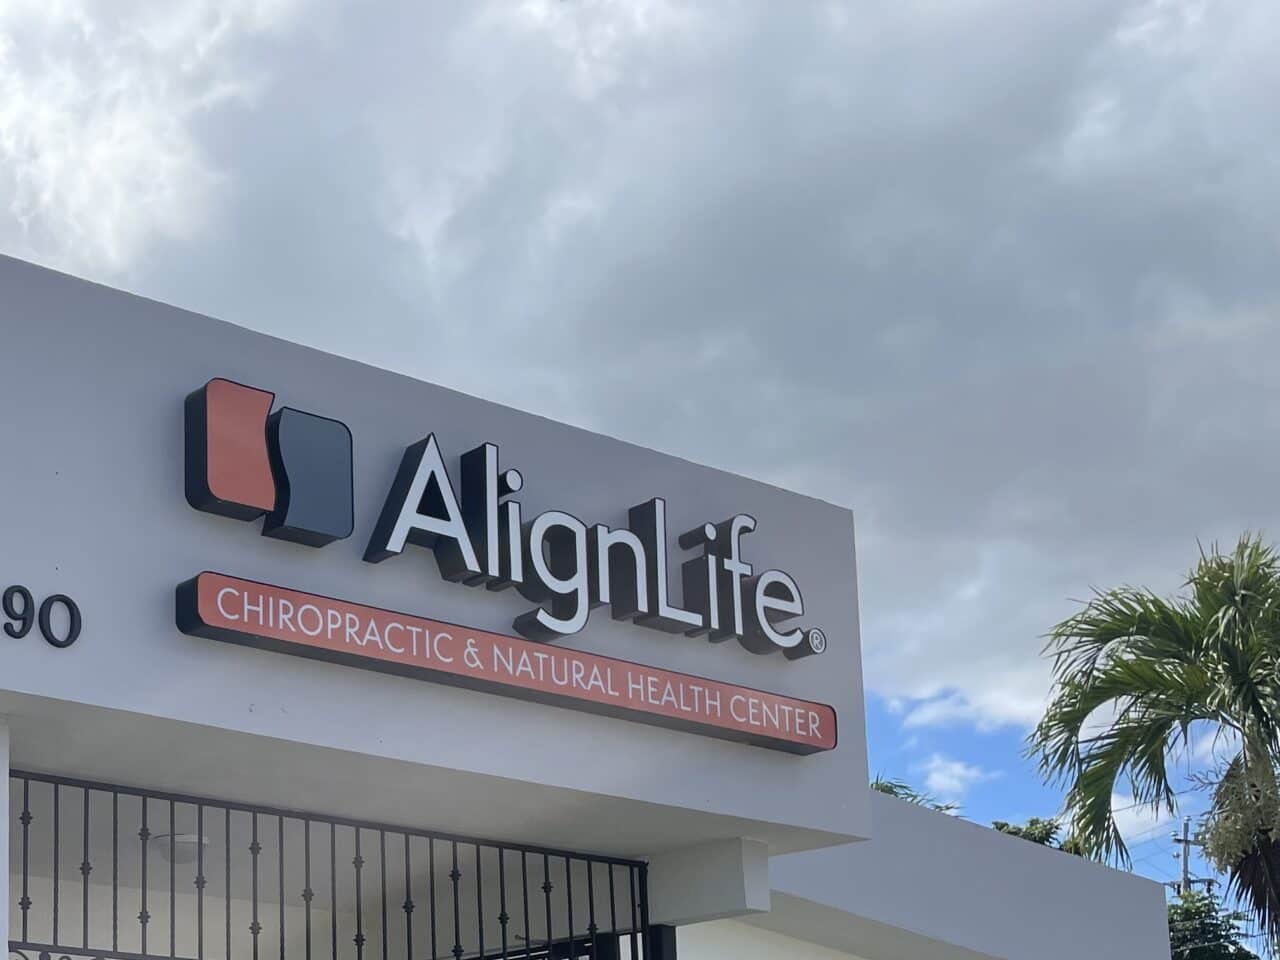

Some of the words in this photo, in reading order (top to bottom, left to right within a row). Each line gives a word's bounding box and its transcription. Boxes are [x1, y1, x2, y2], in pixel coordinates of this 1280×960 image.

[216, 587, 455, 664] CHIROPRACTIC
[463, 637, 487, 669] &
[493, 644, 619, 698] NATURAL
[628, 669, 722, 719] HEALTH
[729, 694, 822, 740] CENTER
